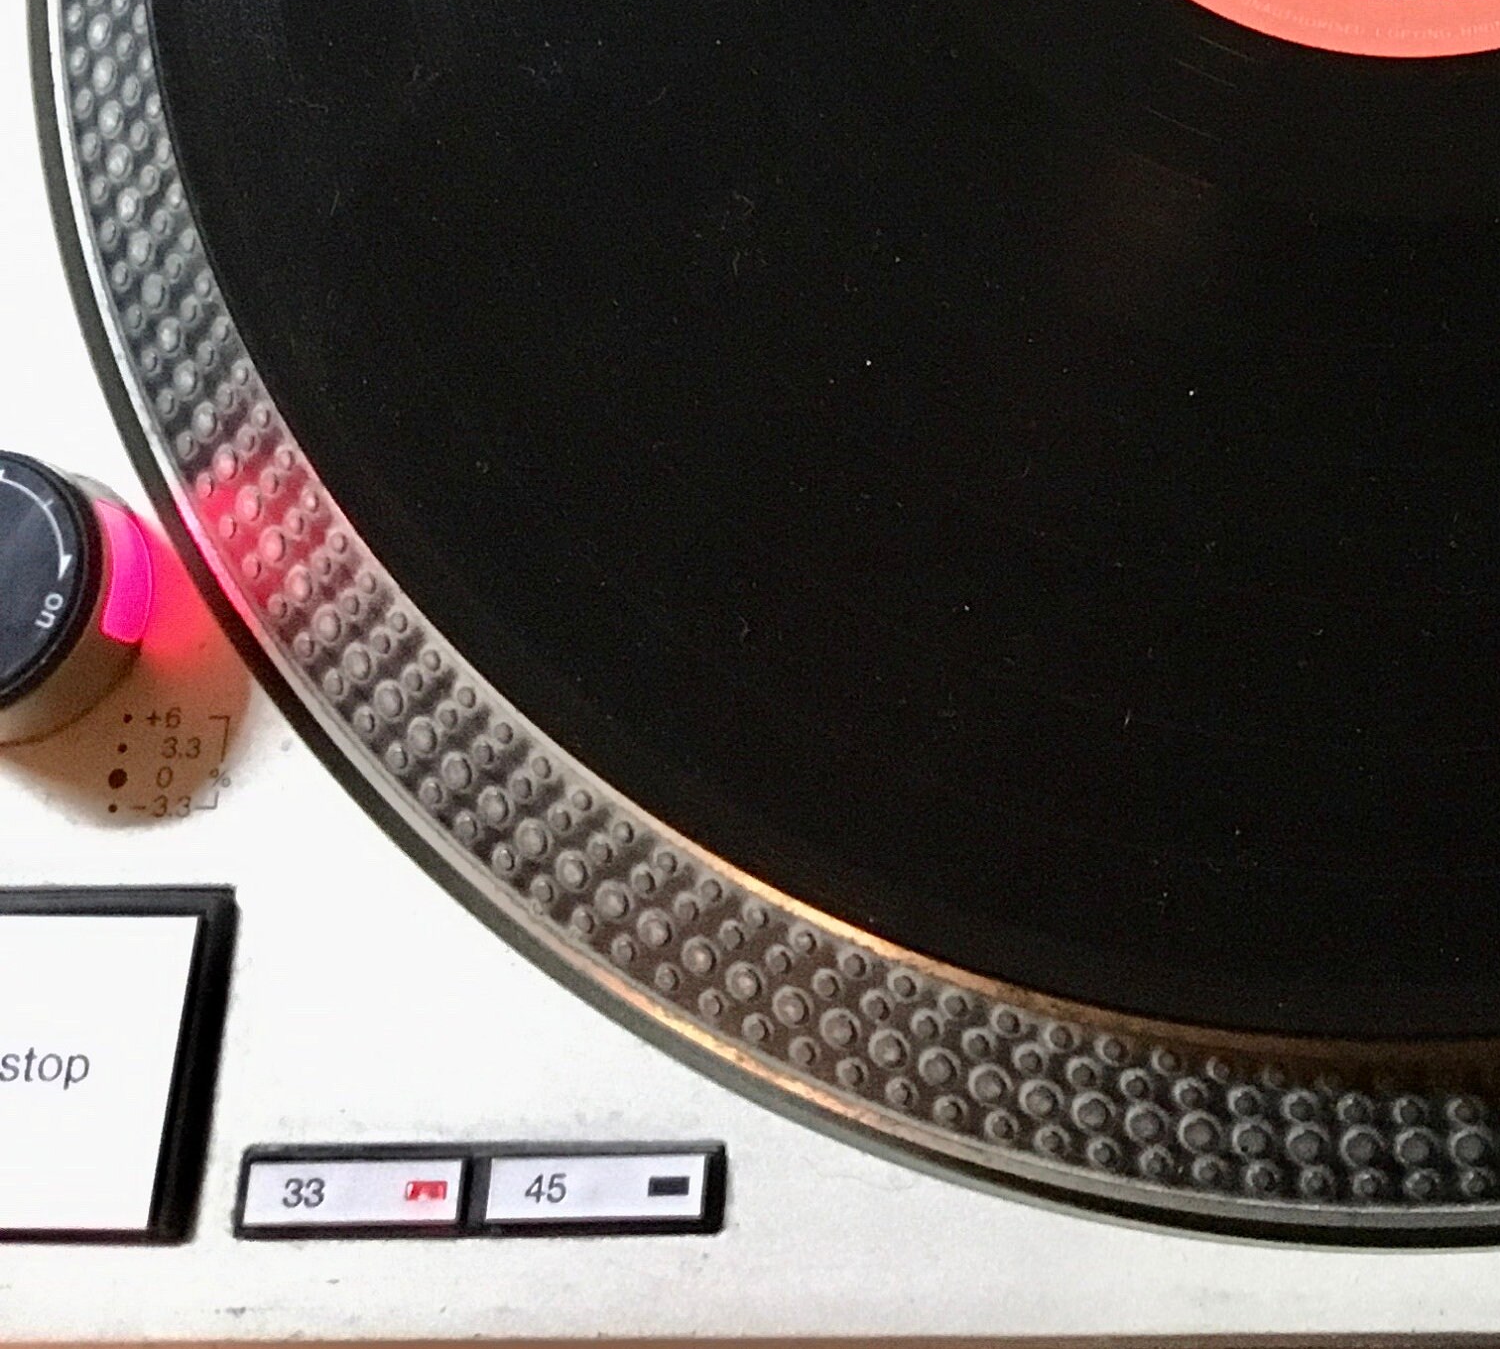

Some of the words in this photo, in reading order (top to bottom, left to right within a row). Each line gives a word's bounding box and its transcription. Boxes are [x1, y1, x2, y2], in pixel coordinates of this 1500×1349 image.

[34, 592, 64, 629] on
[146, 707, 181, 729] +6
[162, 736, 201, 760] 3.3
[156, 766, 173, 789] 0
[209, 768, 231, 788] %
[0, 1046, 90, 1091] stop
[282, 1177, 326, 1209] 33
[525, 1173, 568, 1204] 45
